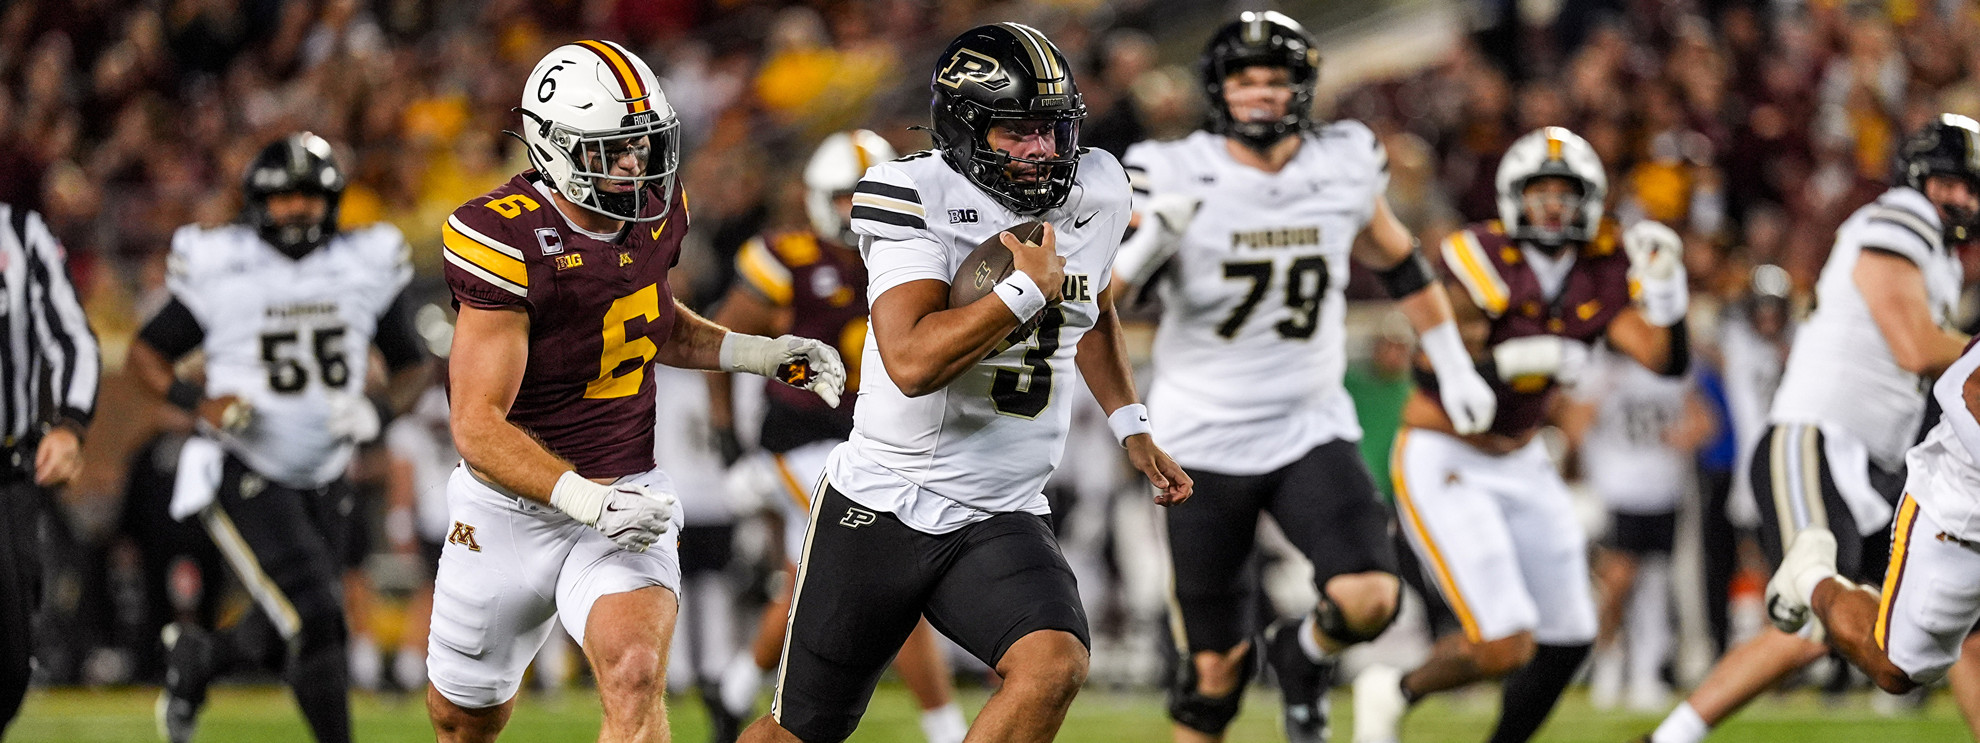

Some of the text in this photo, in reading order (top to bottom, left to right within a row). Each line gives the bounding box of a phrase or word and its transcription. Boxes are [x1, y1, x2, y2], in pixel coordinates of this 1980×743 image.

[537, 65, 564, 103] 6
[937, 48, 999, 89] P
[634, 113, 650, 126] ROW
[484, 194, 541, 219] 6
[537, 229, 561, 253] C
[1217, 257, 1329, 338] 79
[260, 327, 350, 393] 55
[583, 283, 660, 399] 6
[989, 306, 1067, 421] 3
[449, 521, 481, 552] M
[840, 507, 876, 528] P
